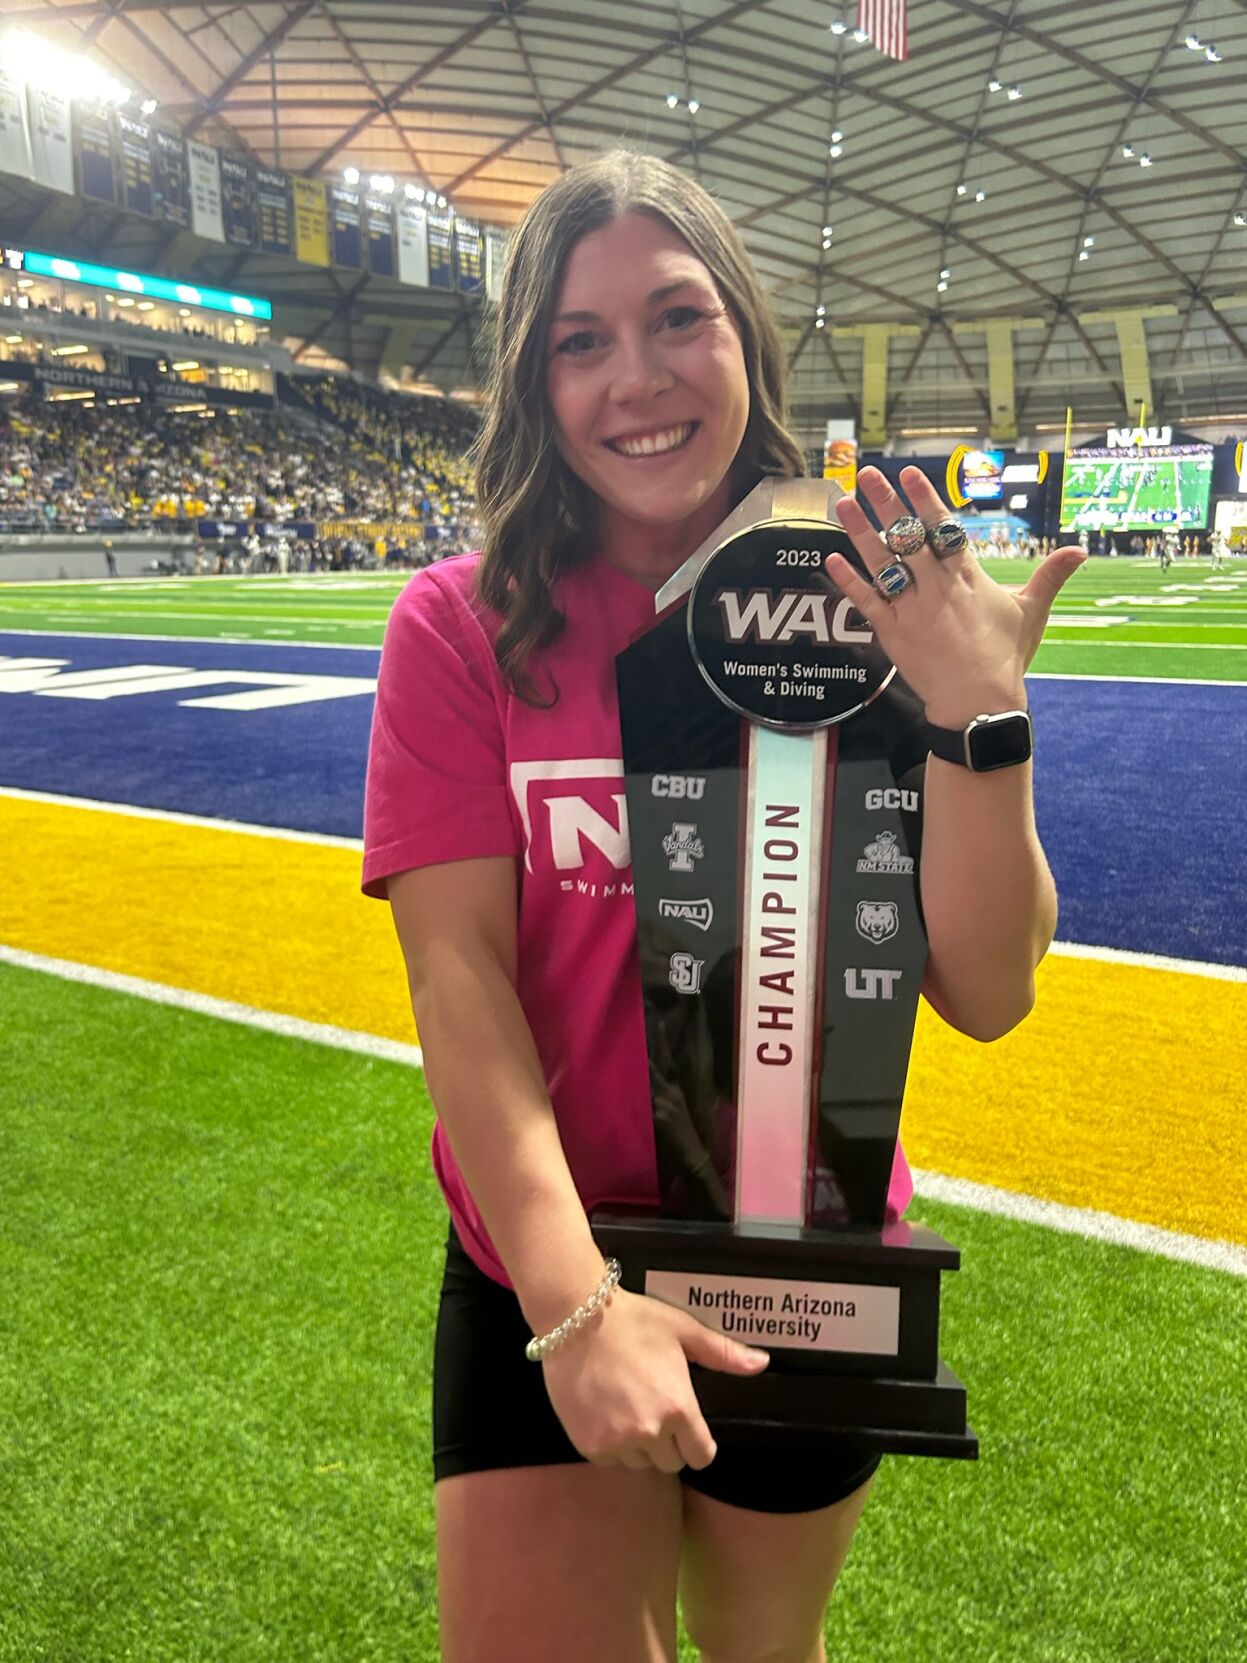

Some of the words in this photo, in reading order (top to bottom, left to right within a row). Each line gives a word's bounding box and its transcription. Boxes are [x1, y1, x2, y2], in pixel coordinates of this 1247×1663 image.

[34, 367, 133, 391] NORTHERN
[1107, 426, 1173, 448] NAU
[776, 549, 821, 567] 2023
[718, 591, 874, 643] WAC
[723, 661, 788, 678] Women's
[793, 663, 867, 683] Swimming
[763, 681, 775, 695] &
[780, 681, 825, 700] Diving
[651, 774, 706, 800] CBU
[865, 788, 919, 812] GCU
[664, 904, 707, 920] NAU
[755, 803, 801, 1067] CHAMPION
[688, 1286, 774, 1312] Northern
[781, 1293, 856, 1318] Arizona
[721, 1312, 822, 1342] University
